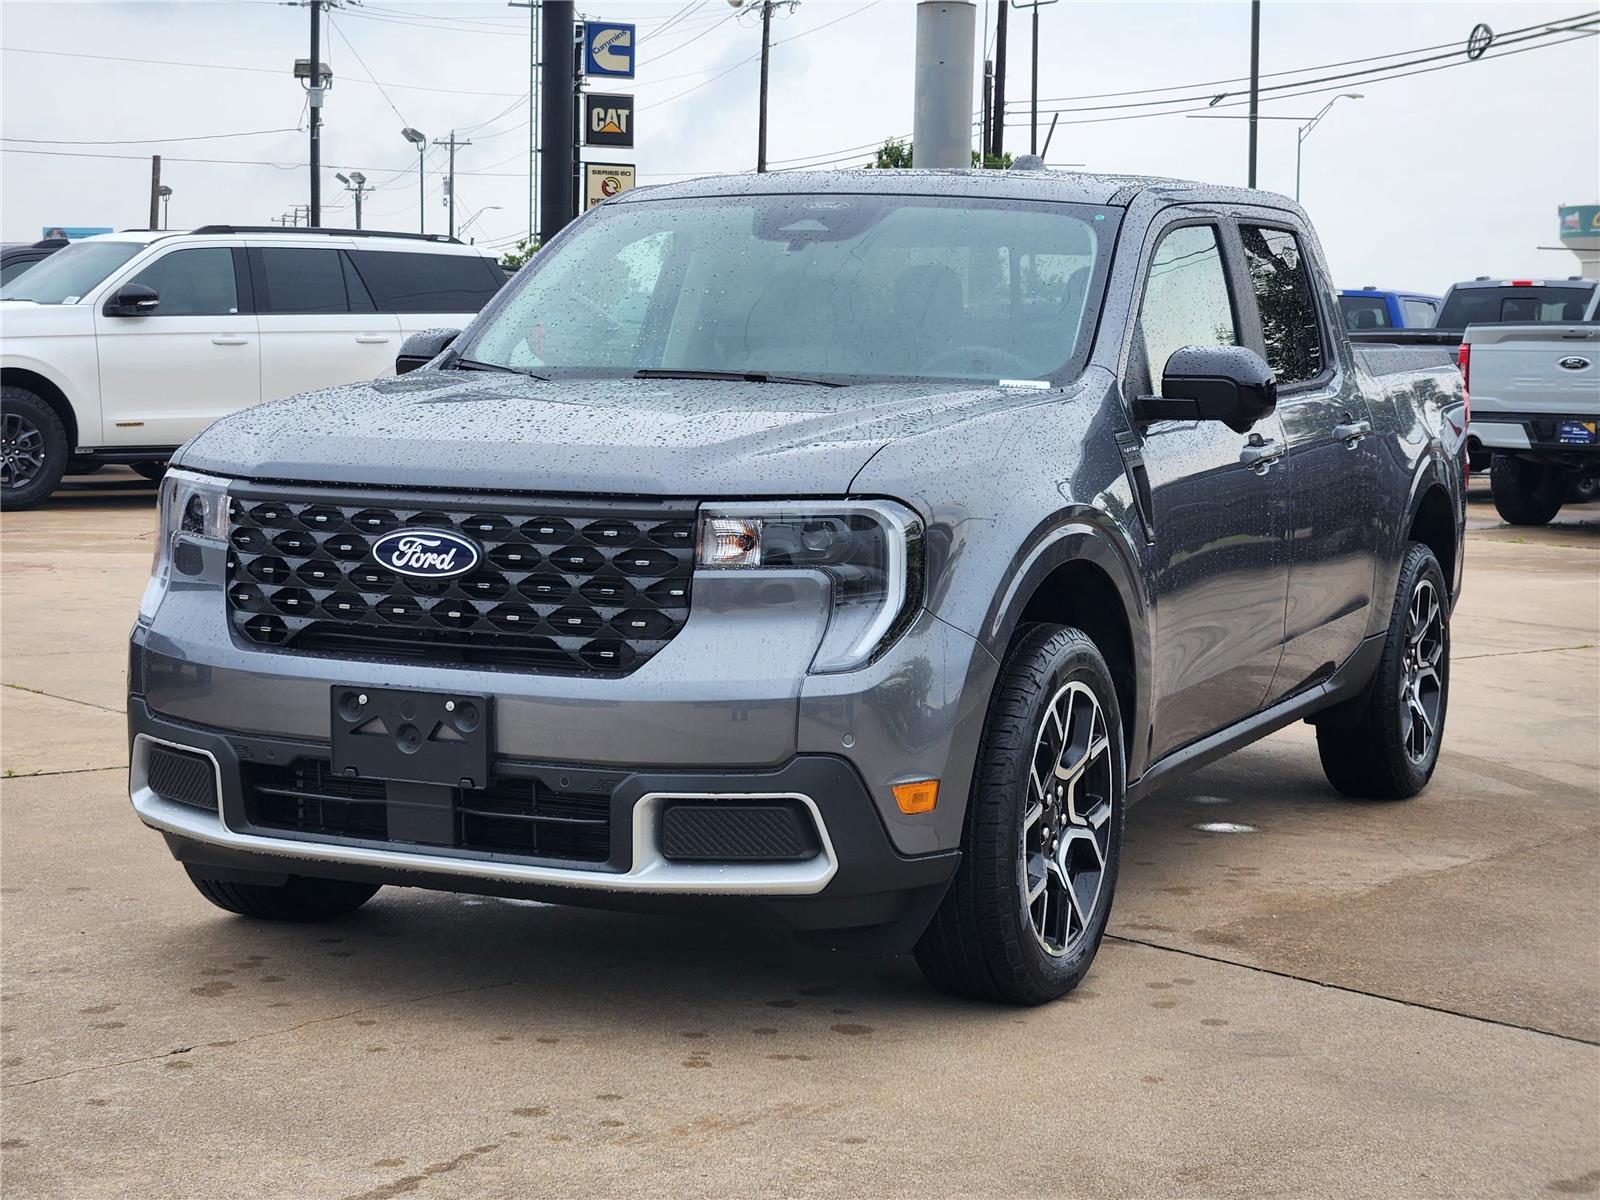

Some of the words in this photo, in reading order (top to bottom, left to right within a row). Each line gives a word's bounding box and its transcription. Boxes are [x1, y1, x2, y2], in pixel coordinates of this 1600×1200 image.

[593, 31, 627, 54] Cummins
[592, 108, 629, 133] CAT
[392, 537, 457, 570] Ford
